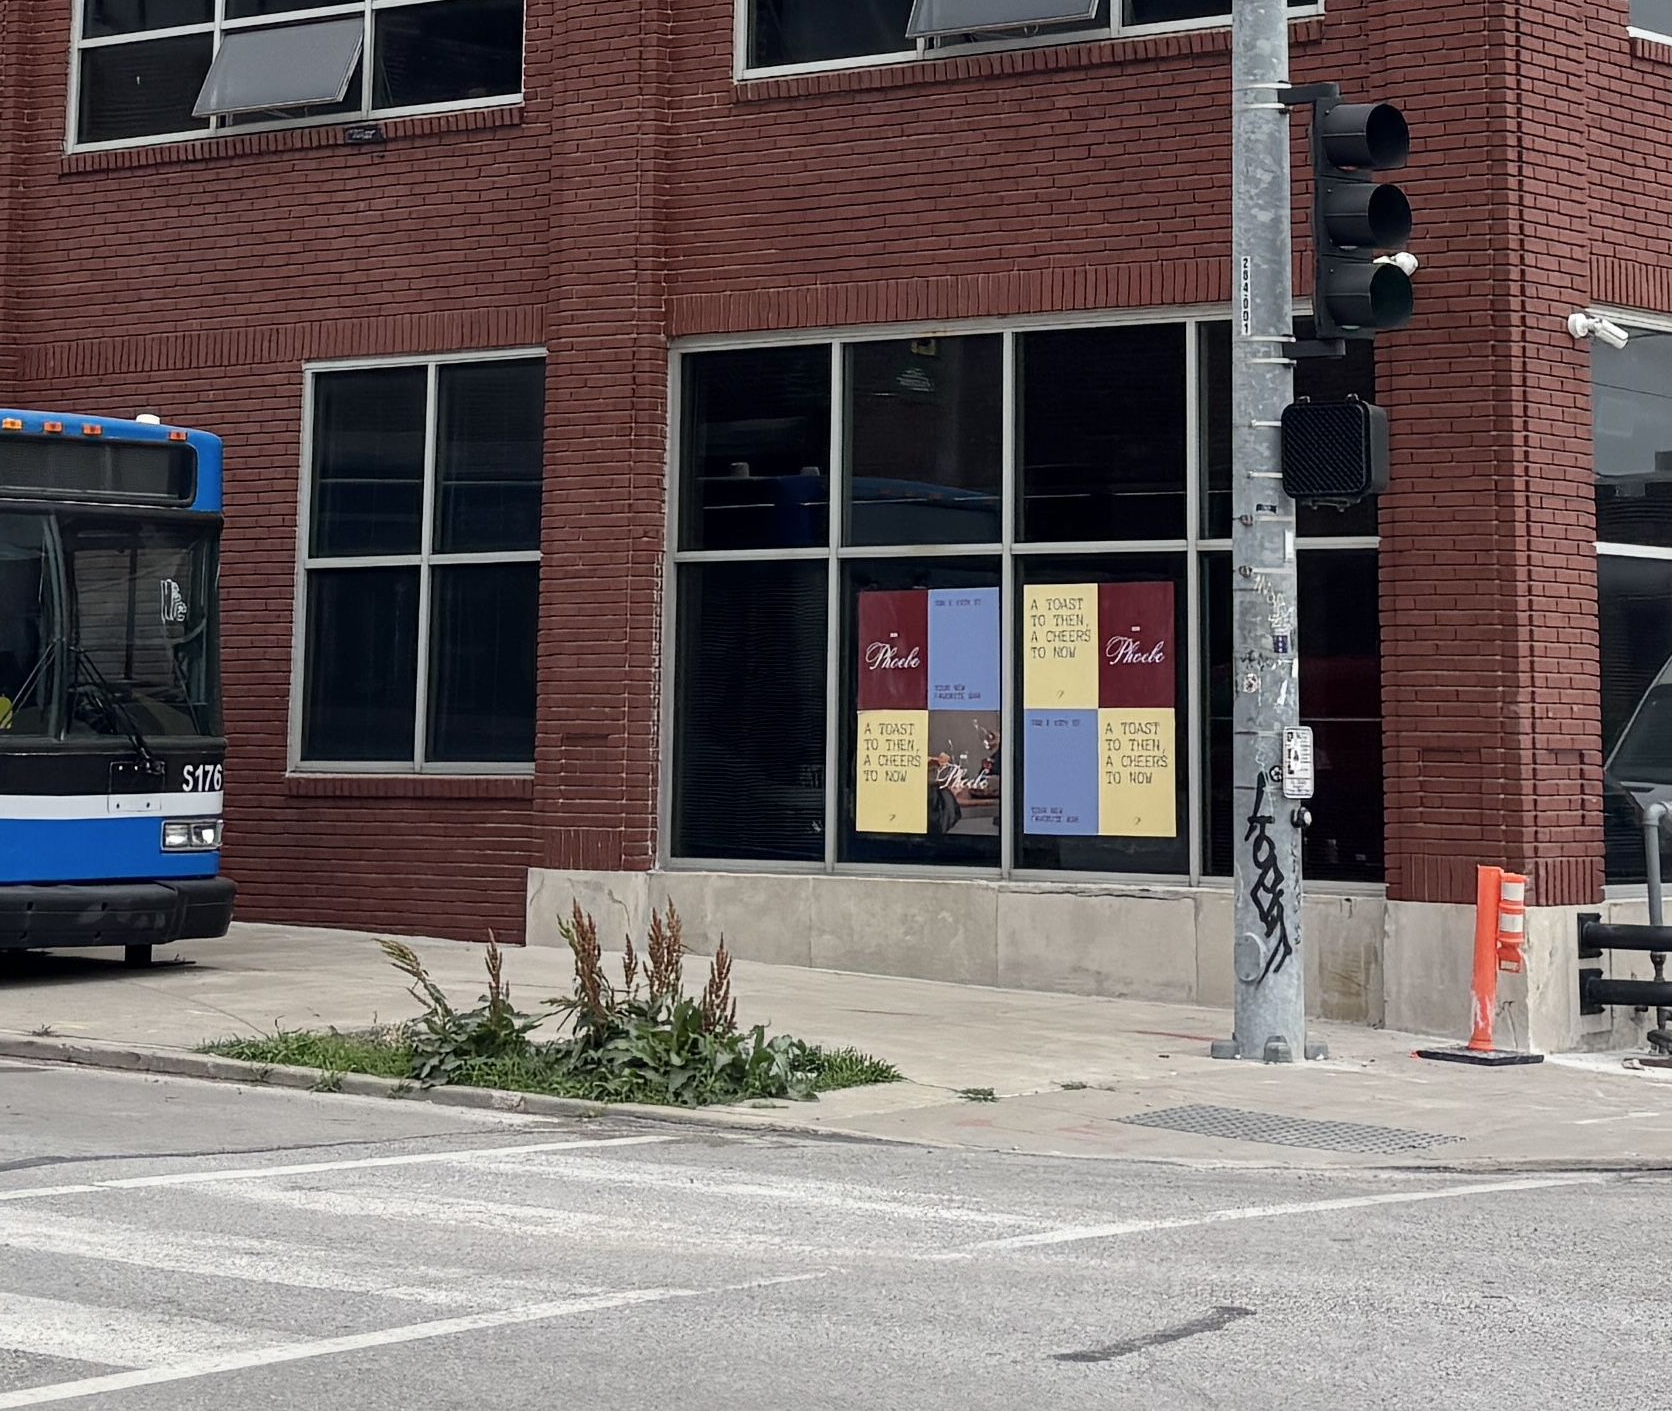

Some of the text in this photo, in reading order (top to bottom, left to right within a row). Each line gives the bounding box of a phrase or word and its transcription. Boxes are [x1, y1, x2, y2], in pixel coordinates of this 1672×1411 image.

[1031, 597, 1084, 611] A TOAST
[1031, 615, 1046, 627] TO
[1031, 629, 1091, 642] A CHEERS
[865, 641, 921, 669] Phoebe
[1031, 646, 1076, 659] TO NOW
[1105, 635, 1165, 665] Phoebe
[864, 723, 914, 735] A TOAST
[1106, 722, 1160, 735] A TOAST
[864, 739, 879, 751] TO
[1106, 738, 1121, 751] TO
[864, 754, 921, 767] A CHEERS
[1106, 755, 1168, 768] A CHEERS
[183, 763, 223, 792] S176
[864, 770, 907, 782] TO NOW
[1106, 771, 1152, 784] TO NOW
